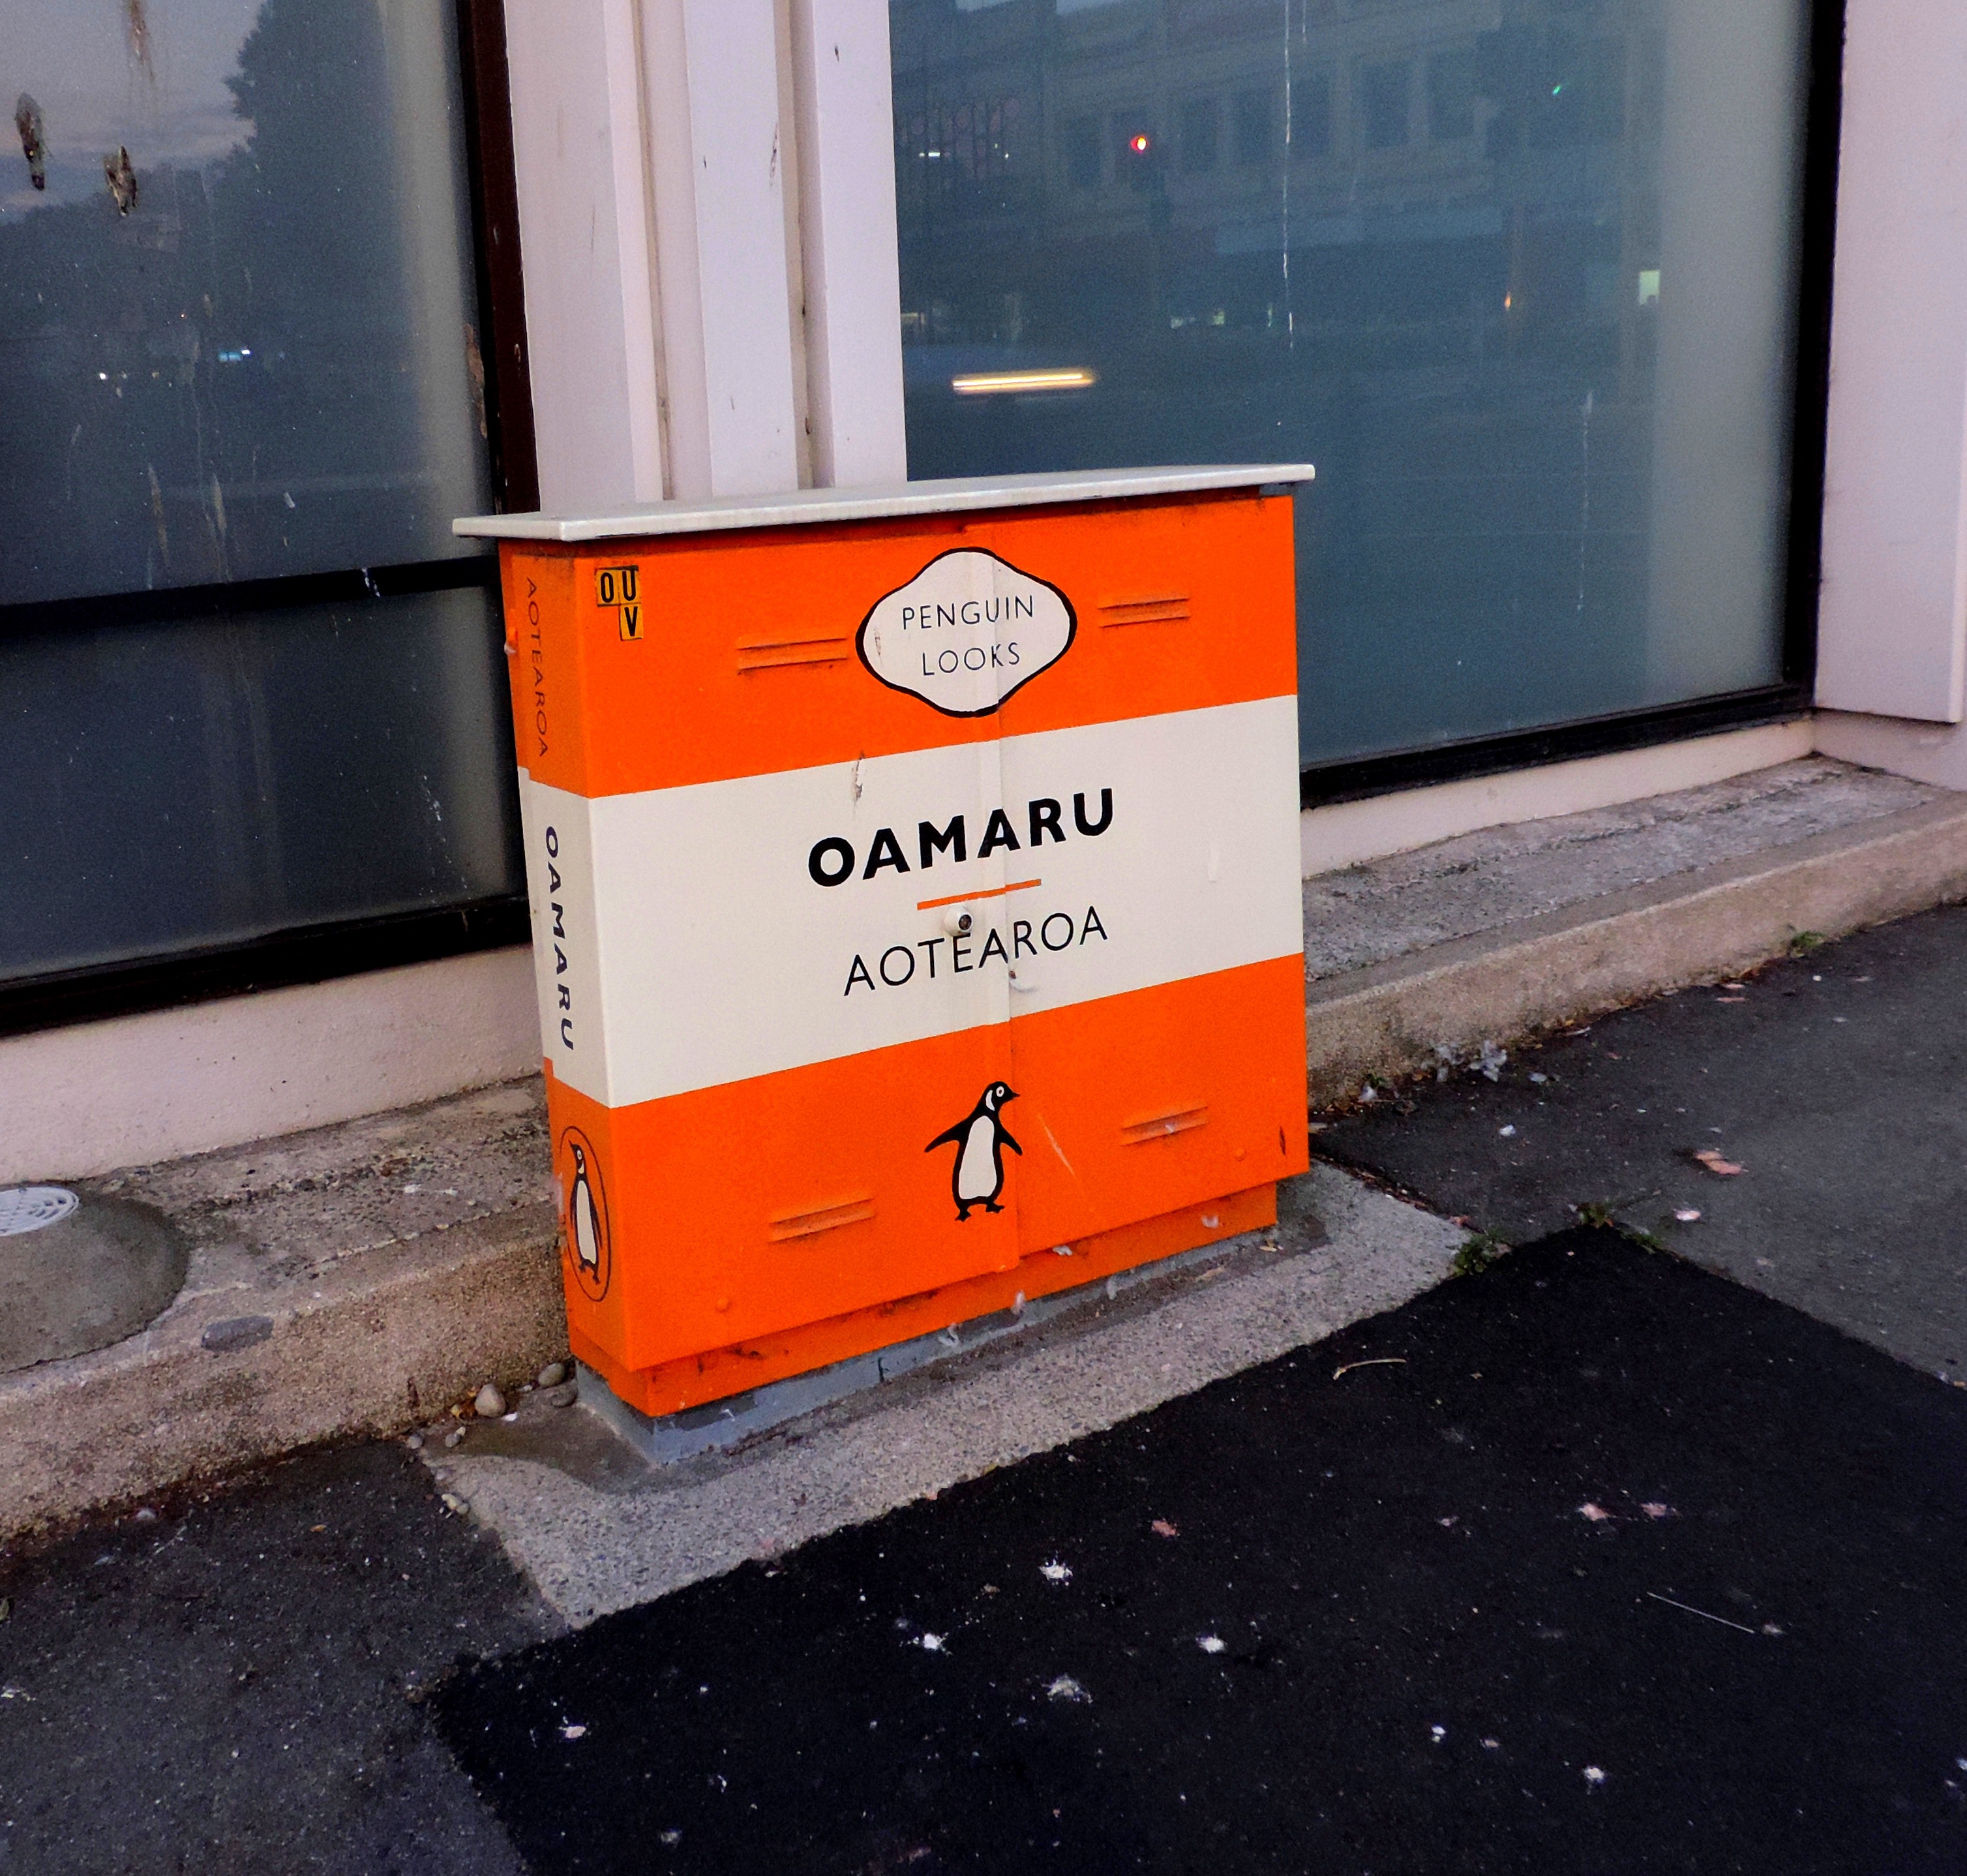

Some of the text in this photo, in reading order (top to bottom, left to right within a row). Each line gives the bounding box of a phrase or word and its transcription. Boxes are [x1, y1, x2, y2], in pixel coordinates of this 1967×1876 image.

[903, 594, 1034, 630] PENGUIN
[922, 641, 1021, 676] LOOKS
[526, 577, 548, 757] AOTEAROA
[808, 787, 1114, 887] OAMARU
[546, 826, 574, 1051] OAMARU
[843, 905, 1109, 997] AOTEAROA
